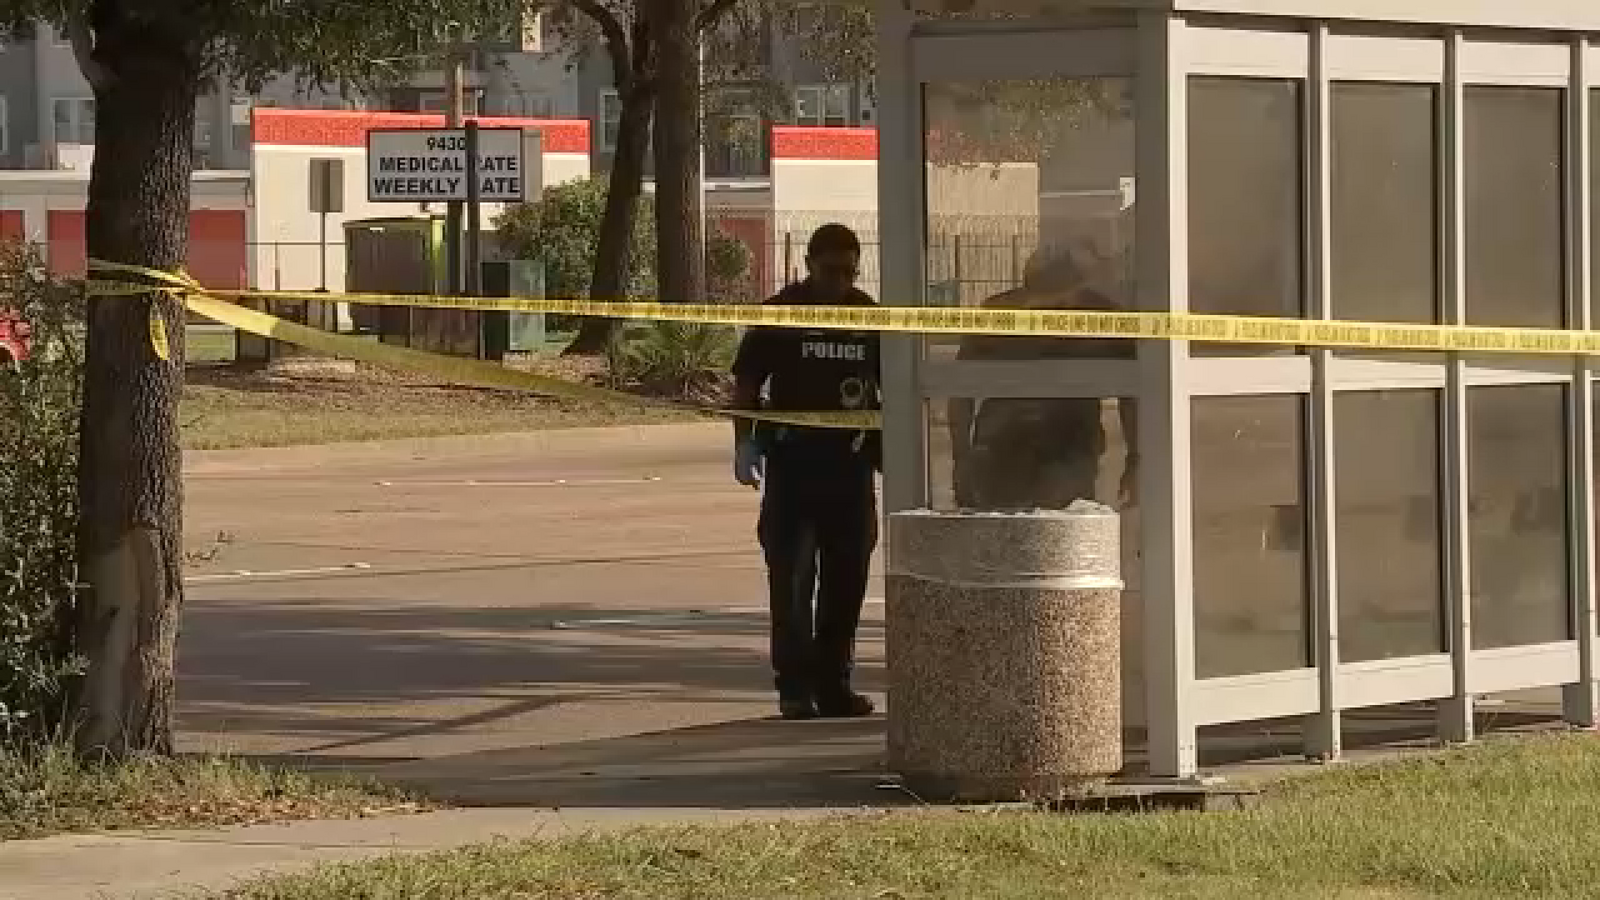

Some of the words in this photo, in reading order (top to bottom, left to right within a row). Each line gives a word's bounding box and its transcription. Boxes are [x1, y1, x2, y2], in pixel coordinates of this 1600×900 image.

[427, 137, 466, 151] 9430
[379, 157, 463, 171] MEDICAL
[374, 177, 461, 194] WEEKLY
[480, 177, 521, 194] ATE
[802, 342, 866, 360] POLICE
